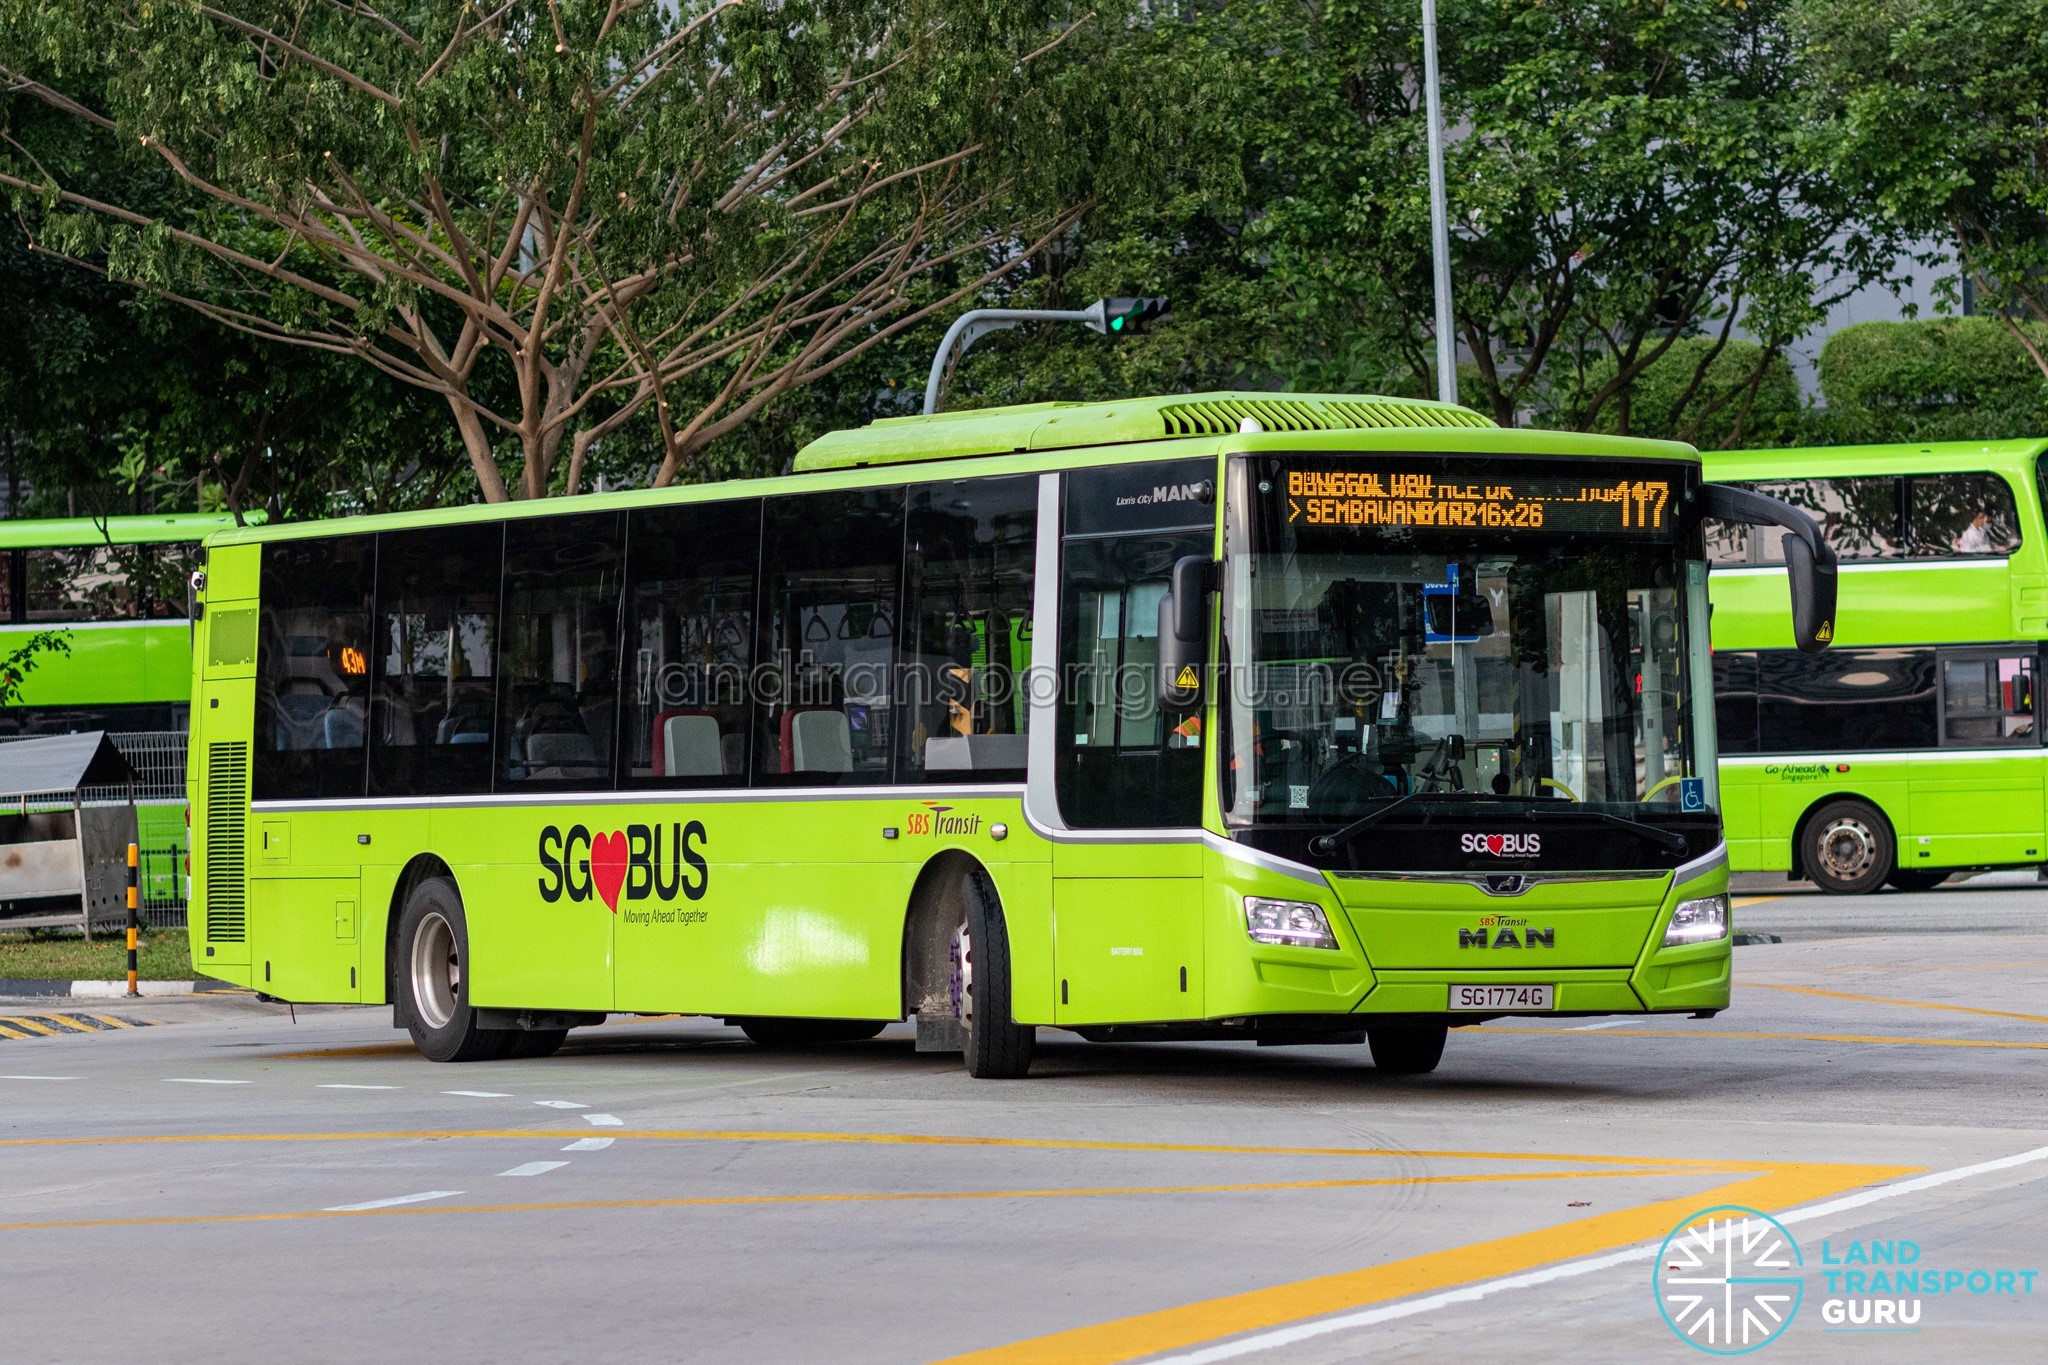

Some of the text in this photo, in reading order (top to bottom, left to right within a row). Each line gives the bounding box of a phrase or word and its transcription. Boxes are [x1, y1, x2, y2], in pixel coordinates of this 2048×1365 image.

[1137, 494, 1152, 505] City
[1153, 484, 1196, 502] MAN
[1616, 481, 1669, 527] 117
[1765, 764, 1817, 774] Go-Ahead
[906, 806, 984, 839] SBS Transit
[623, 908, 708, 926] Moving Ahead Together
[1480, 915, 1529, 927] SBS Transit
[1459, 928, 1554, 948] MAN
[1461, 988, 1543, 1006] SG1774G
